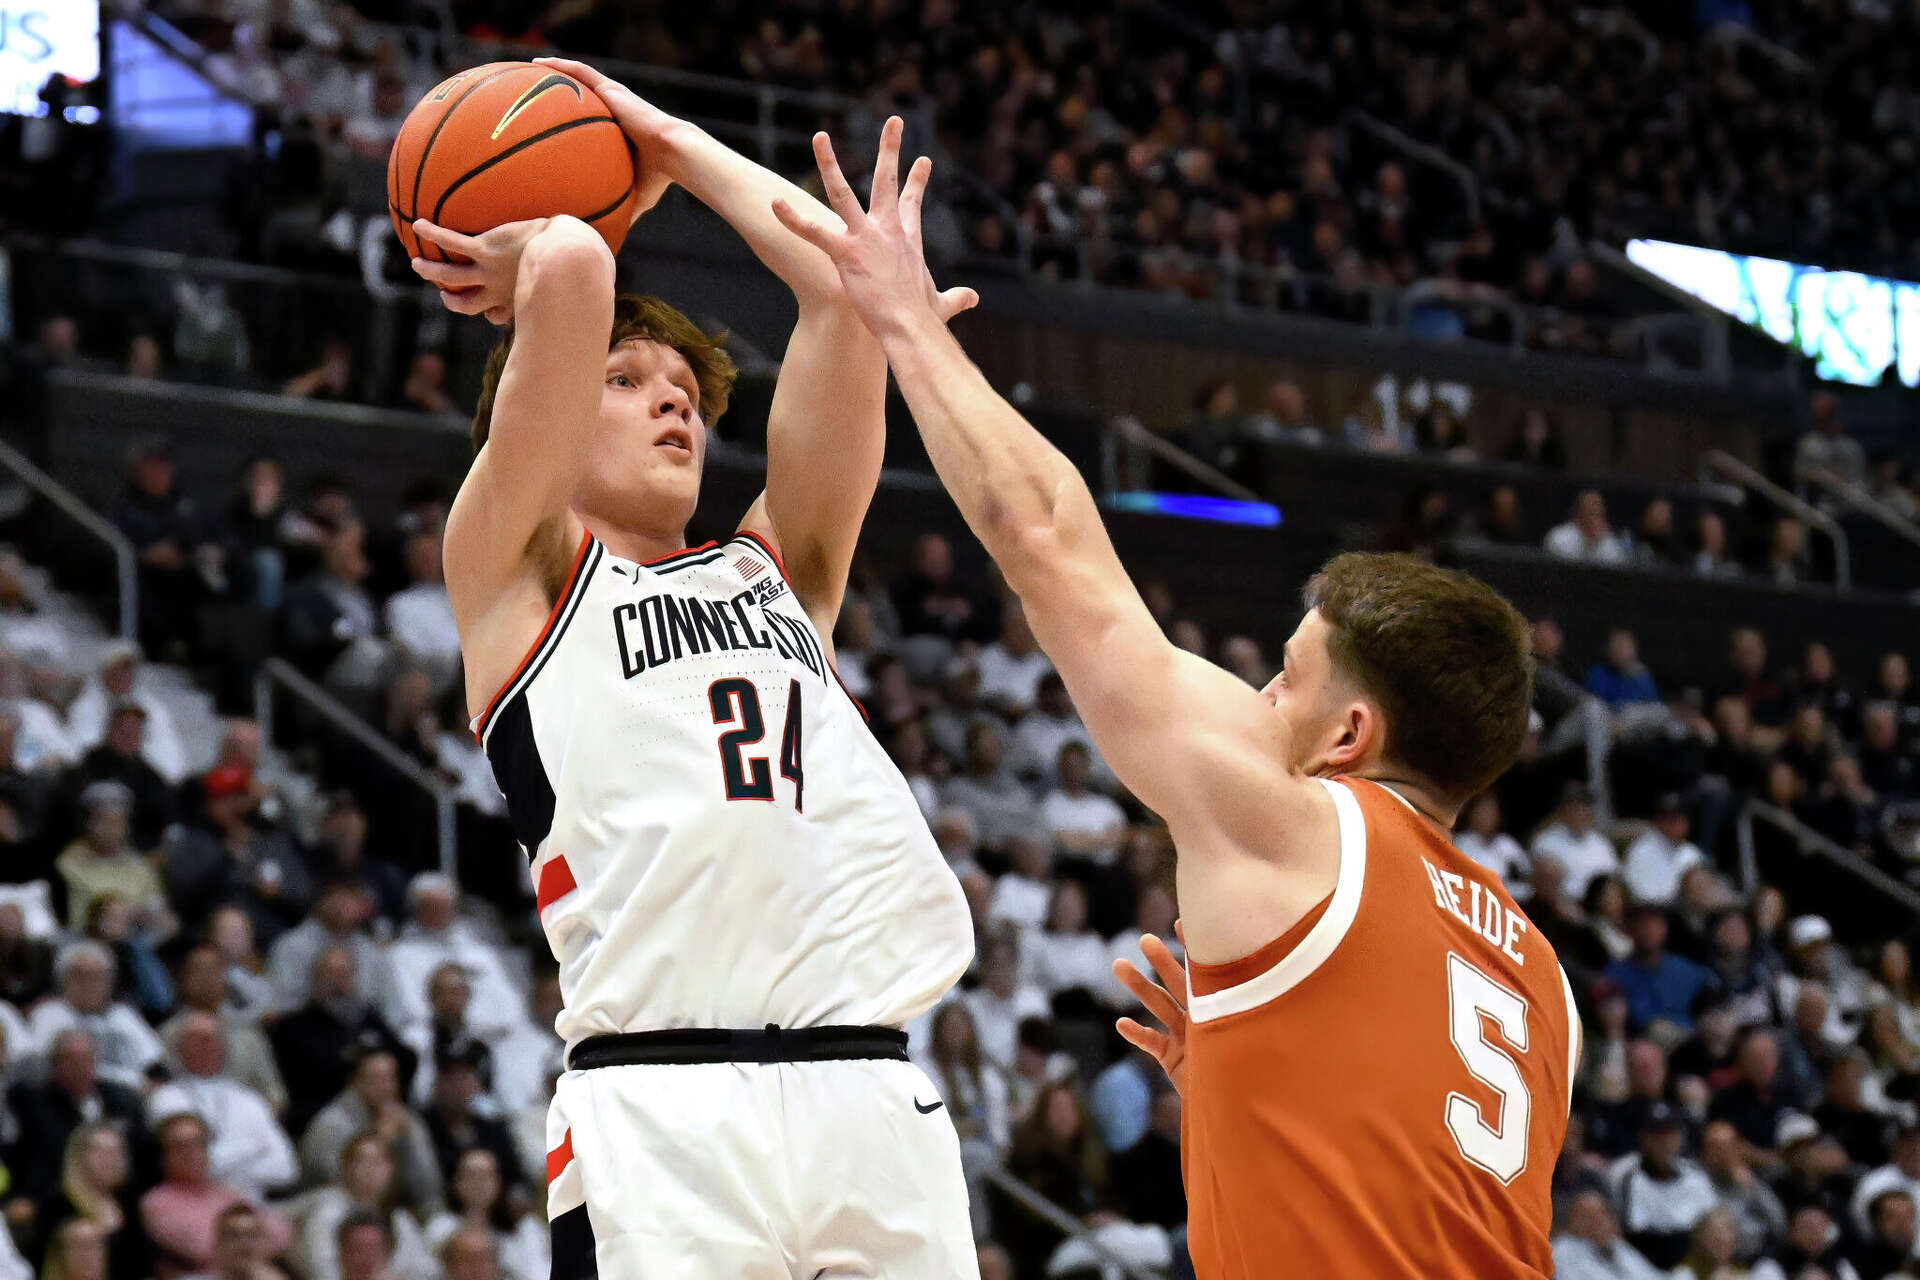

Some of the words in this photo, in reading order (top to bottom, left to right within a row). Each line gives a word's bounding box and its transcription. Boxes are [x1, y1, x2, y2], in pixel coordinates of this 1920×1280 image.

[760, 580, 786, 606] AST
[1421, 856, 1527, 966] HEIDE
[1445, 951, 1532, 1186] 5
